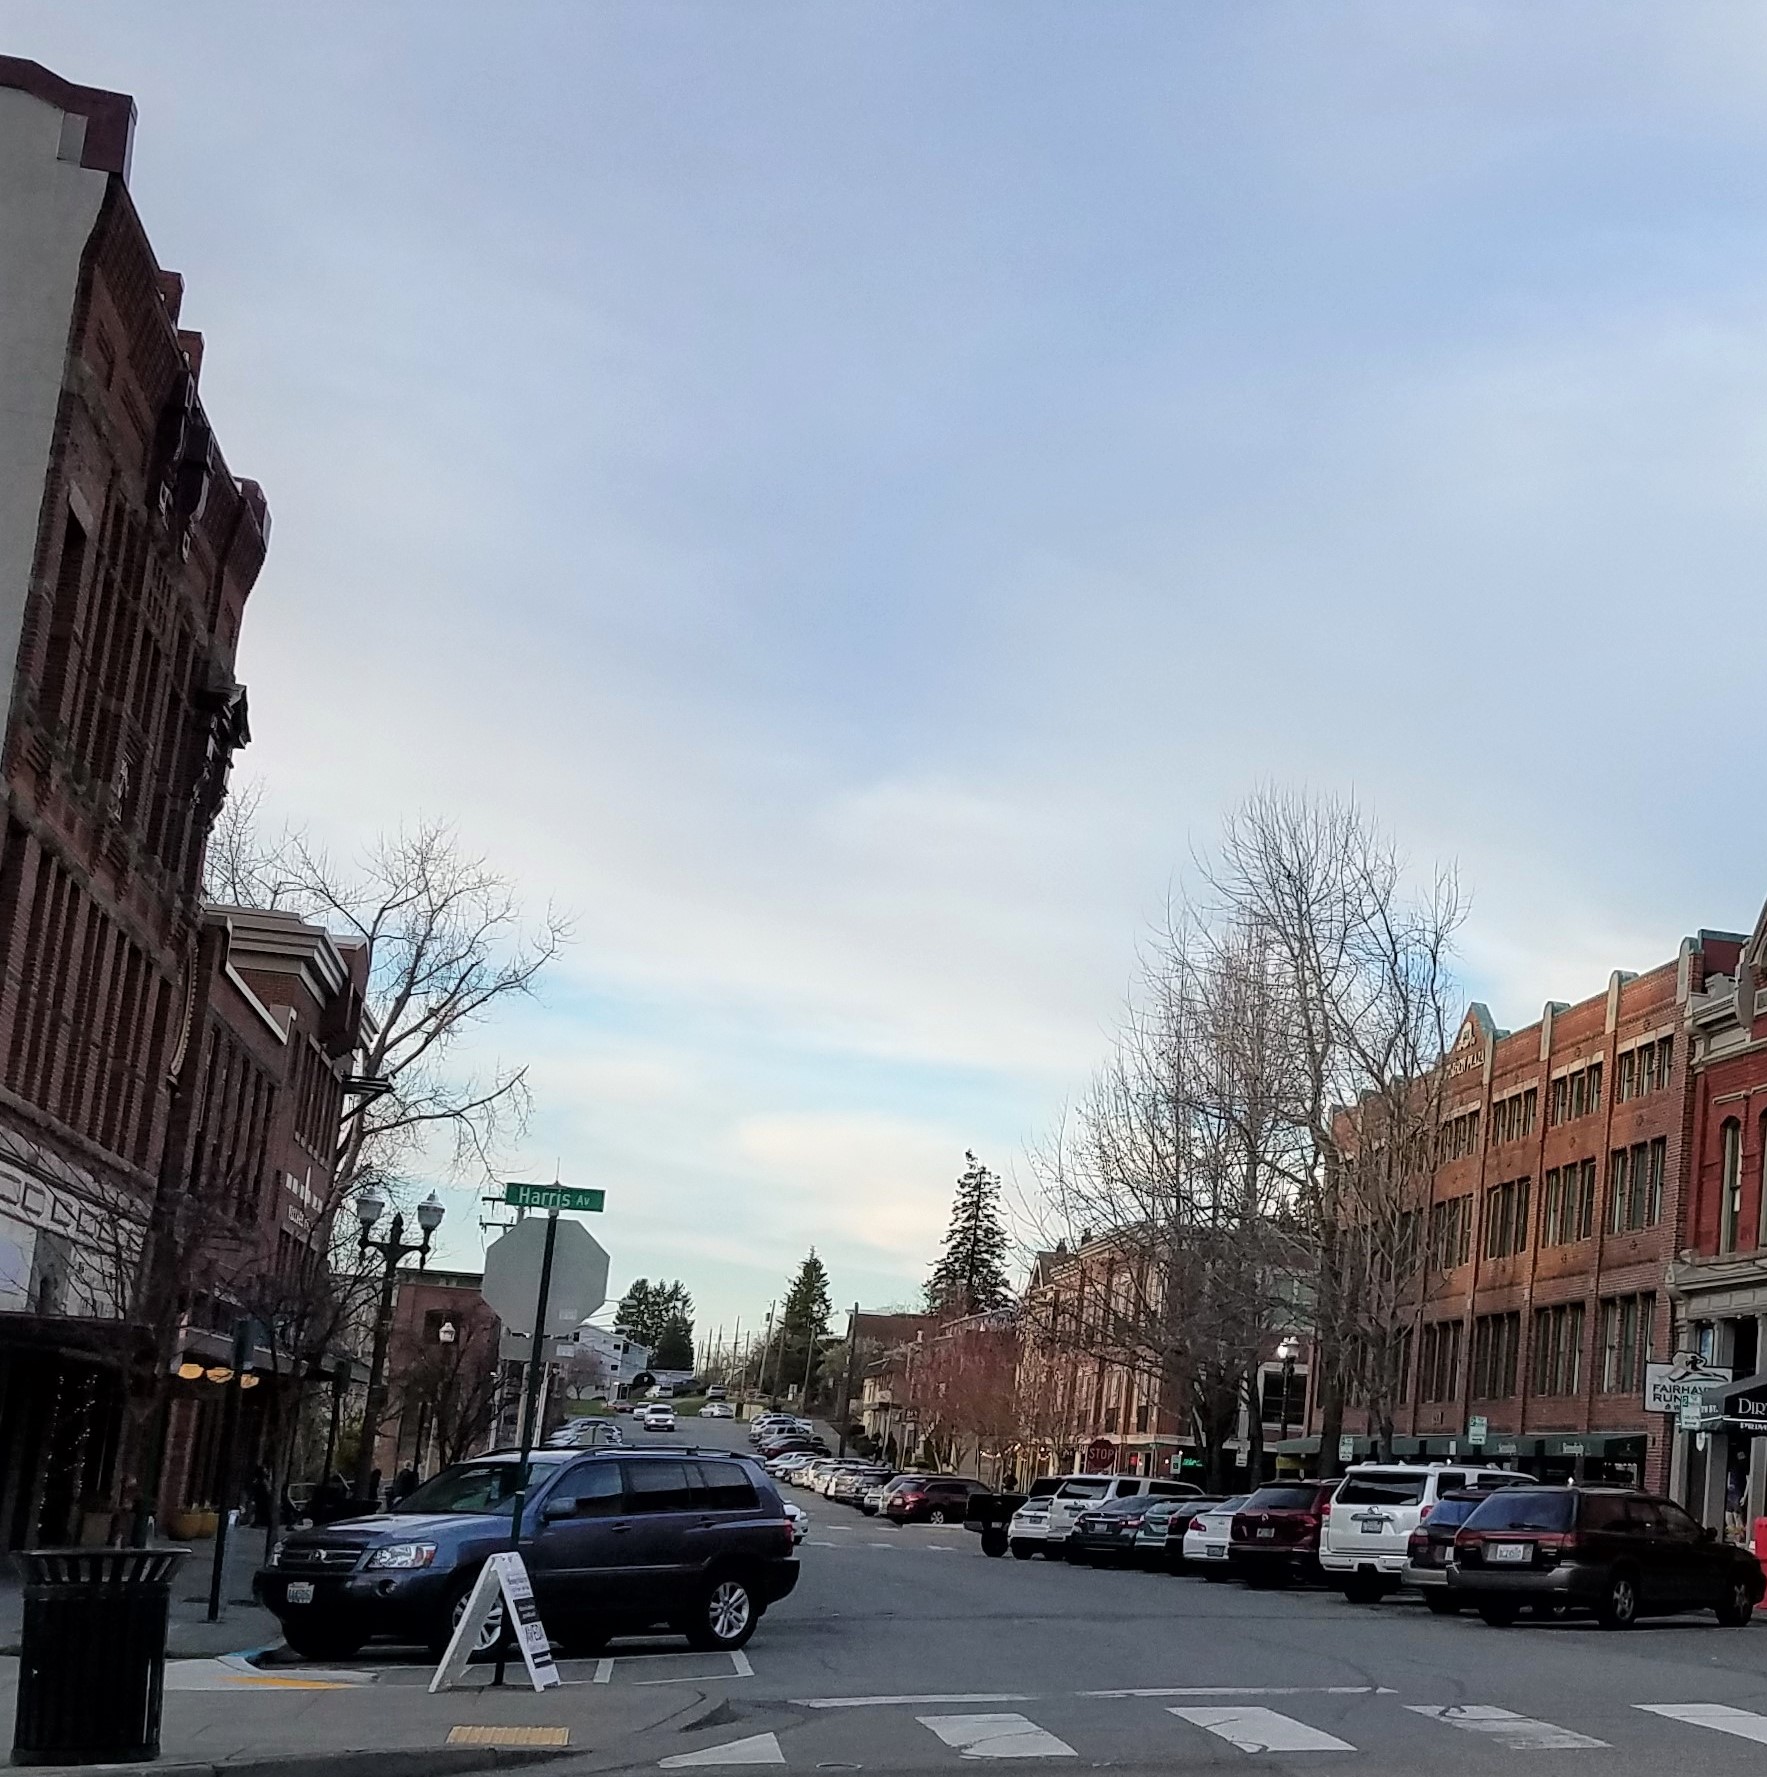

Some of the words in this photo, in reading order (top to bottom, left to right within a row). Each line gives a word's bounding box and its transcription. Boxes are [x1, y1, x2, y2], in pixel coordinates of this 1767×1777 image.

[519, 1187, 571, 1208] Harris
[576, 1194, 590, 1207] Av
[1652, 1384, 1708, 1395] FAIRHAV
[1088, 1447, 1115, 1460] STOP
